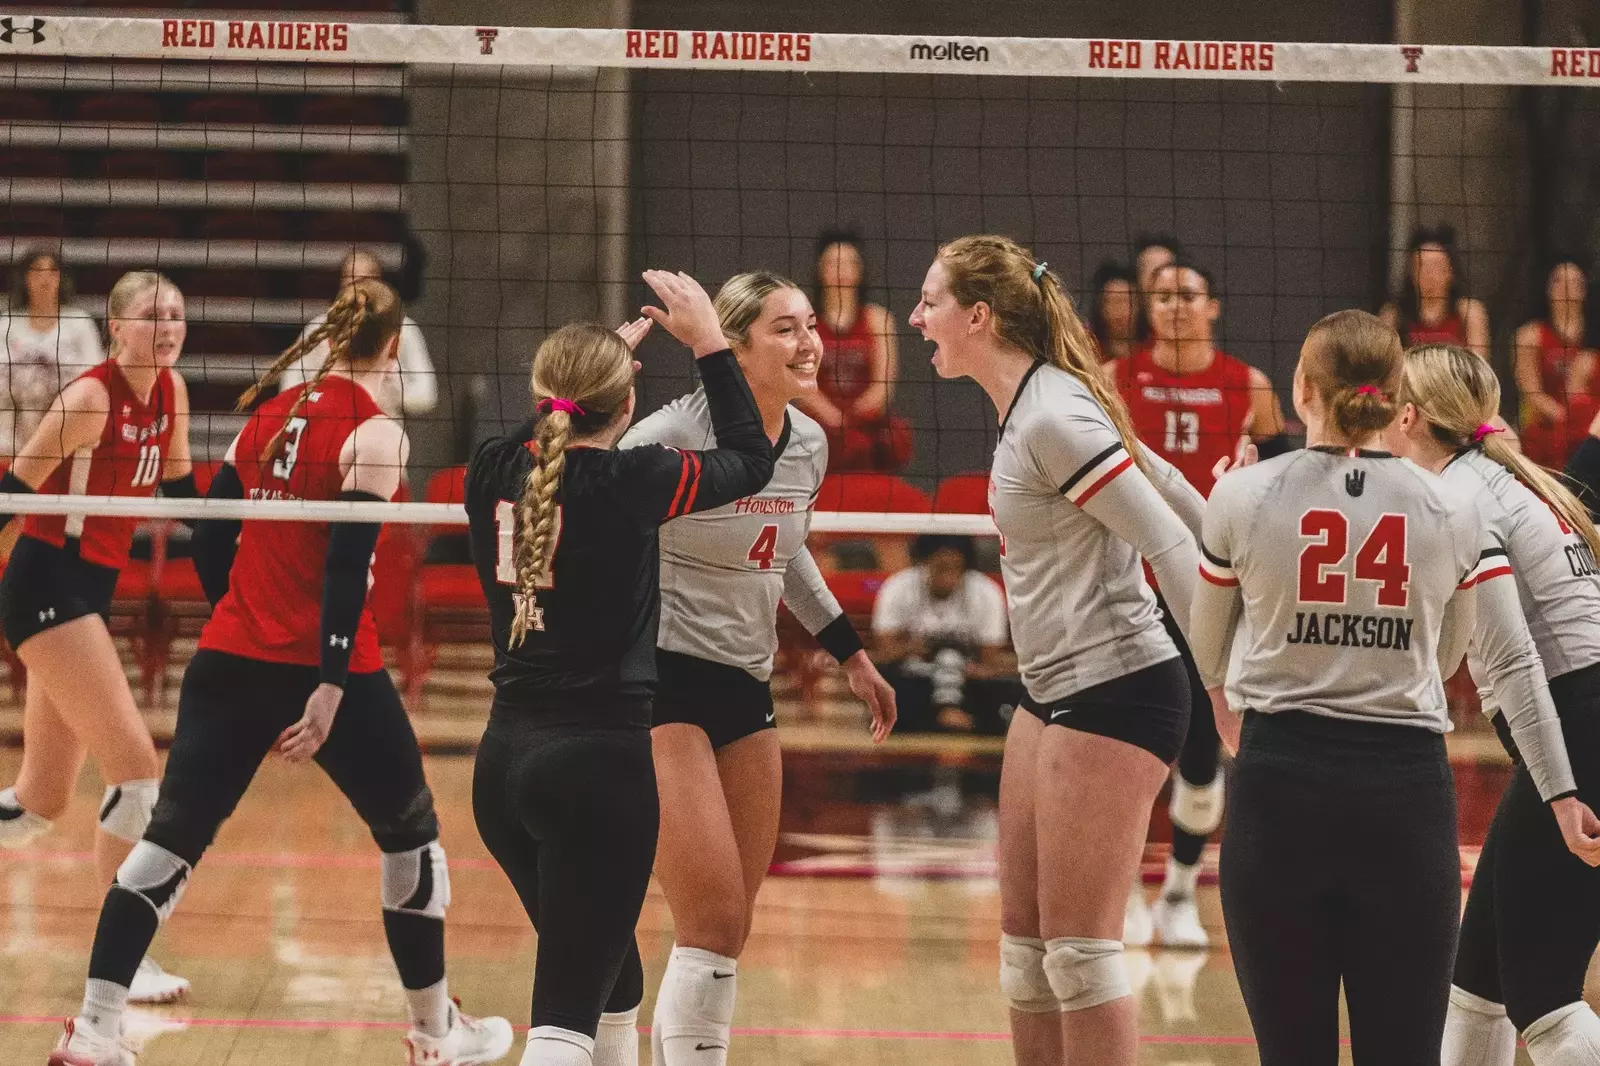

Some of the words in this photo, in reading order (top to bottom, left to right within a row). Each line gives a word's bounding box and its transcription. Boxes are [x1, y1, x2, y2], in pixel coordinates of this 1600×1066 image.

[163, 19, 215, 48] RED
[228, 21, 347, 51] RAIDERS
[626, 30, 679, 59] RED
[692, 31, 812, 62] RAIDERS
[910, 41, 989, 62] molten
[1089, 40, 1142, 69] RED
[1154, 42, 1273, 71] RAIDERS
[1551, 49, 1600, 78] RED
[272, 416, 308, 480] 3
[1164, 410, 1200, 453] 13
[130, 445, 160, 487] 10
[734, 494, 795, 515] Houston
[745, 523, 779, 570] 4
[1297, 507, 1411, 609] 24
[1286, 611, 1415, 652] JACKSON
